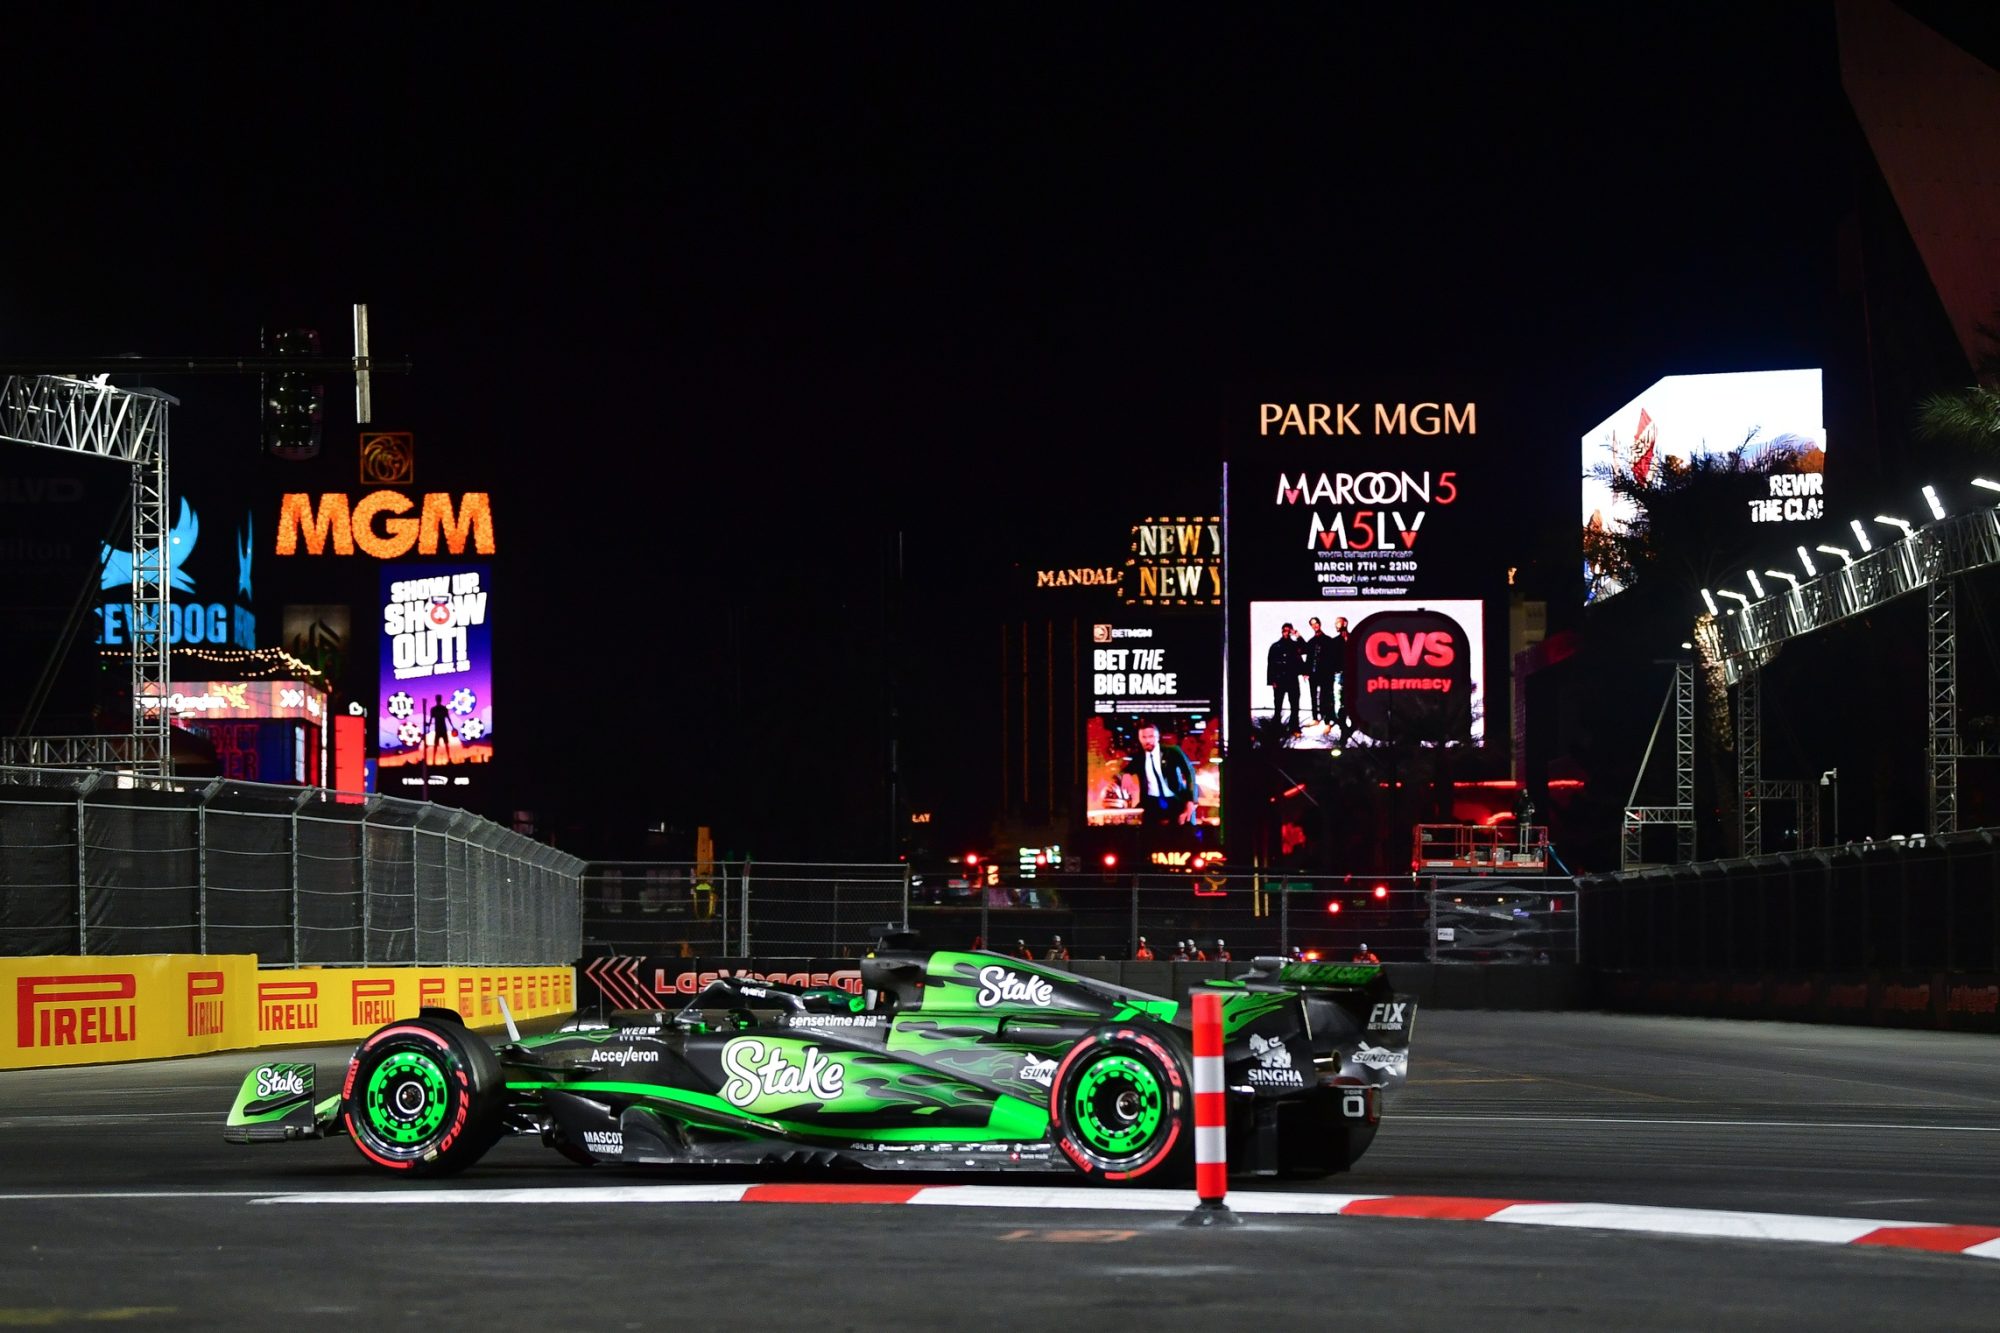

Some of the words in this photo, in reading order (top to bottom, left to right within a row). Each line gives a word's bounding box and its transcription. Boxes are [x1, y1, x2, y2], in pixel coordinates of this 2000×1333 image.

[1260, 403, 1362, 436] PARK
[1375, 402, 1476, 436] MGM
[1276, 470, 1431, 505] MAROON
[1435, 472, 1457, 504] 5
[1769, 472, 1824, 497] REWR
[275, 489, 496, 559] MGM
[1748, 498, 1783, 522] THE
[1139, 524, 1202, 556] NEW
[1307, 510, 1426, 550] M5LV
[1036, 566, 1119, 587] MANDAL
[1314, 561, 1353, 571] MARCH
[1357, 561, 1377, 571] 7TH
[1389, 561, 1418, 571] 22ND
[1330, 574, 1353, 584] Dolby
[391, 575, 451, 603] SHOW
[1139, 565, 1203, 597] NEW
[94, 602, 227, 645] EWDOG
[384, 591, 488, 636] SHOW
[392, 626, 467, 669] OUT!
[1094, 649, 1130, 671] BET
[1132, 649, 1166, 671] THE
[1365, 631, 1455, 668] CVS
[1094, 673, 1126, 695] BIG
[1129, 673, 1178, 695] RACE
[1367, 676, 1452, 693] pharmacy
[979, 965, 1054, 1007] Stake
[17, 973, 137, 1048] PIRELLI
[258, 981, 318, 1032] PIRELLI
[352, 979, 395, 1026] PIRELLI
[1370, 1003, 1407, 1023] FIX
[788, 1014, 853, 1027] sensetime
[1367, 1023, 1403, 1031] NETWORK
[1022, 1066, 1056, 1078] SUN
[1354, 1052, 1402, 1063] SUNOCO
[256, 1067, 305, 1098] Stake
[723, 1039, 844, 1107] Stake
[1248, 1069, 1303, 1083] SINGHA
[441, 1089, 469, 1152] ZERO
[583, 1131, 623, 1145] MASCOT
[587, 1143, 624, 1155] WORKWEAR
